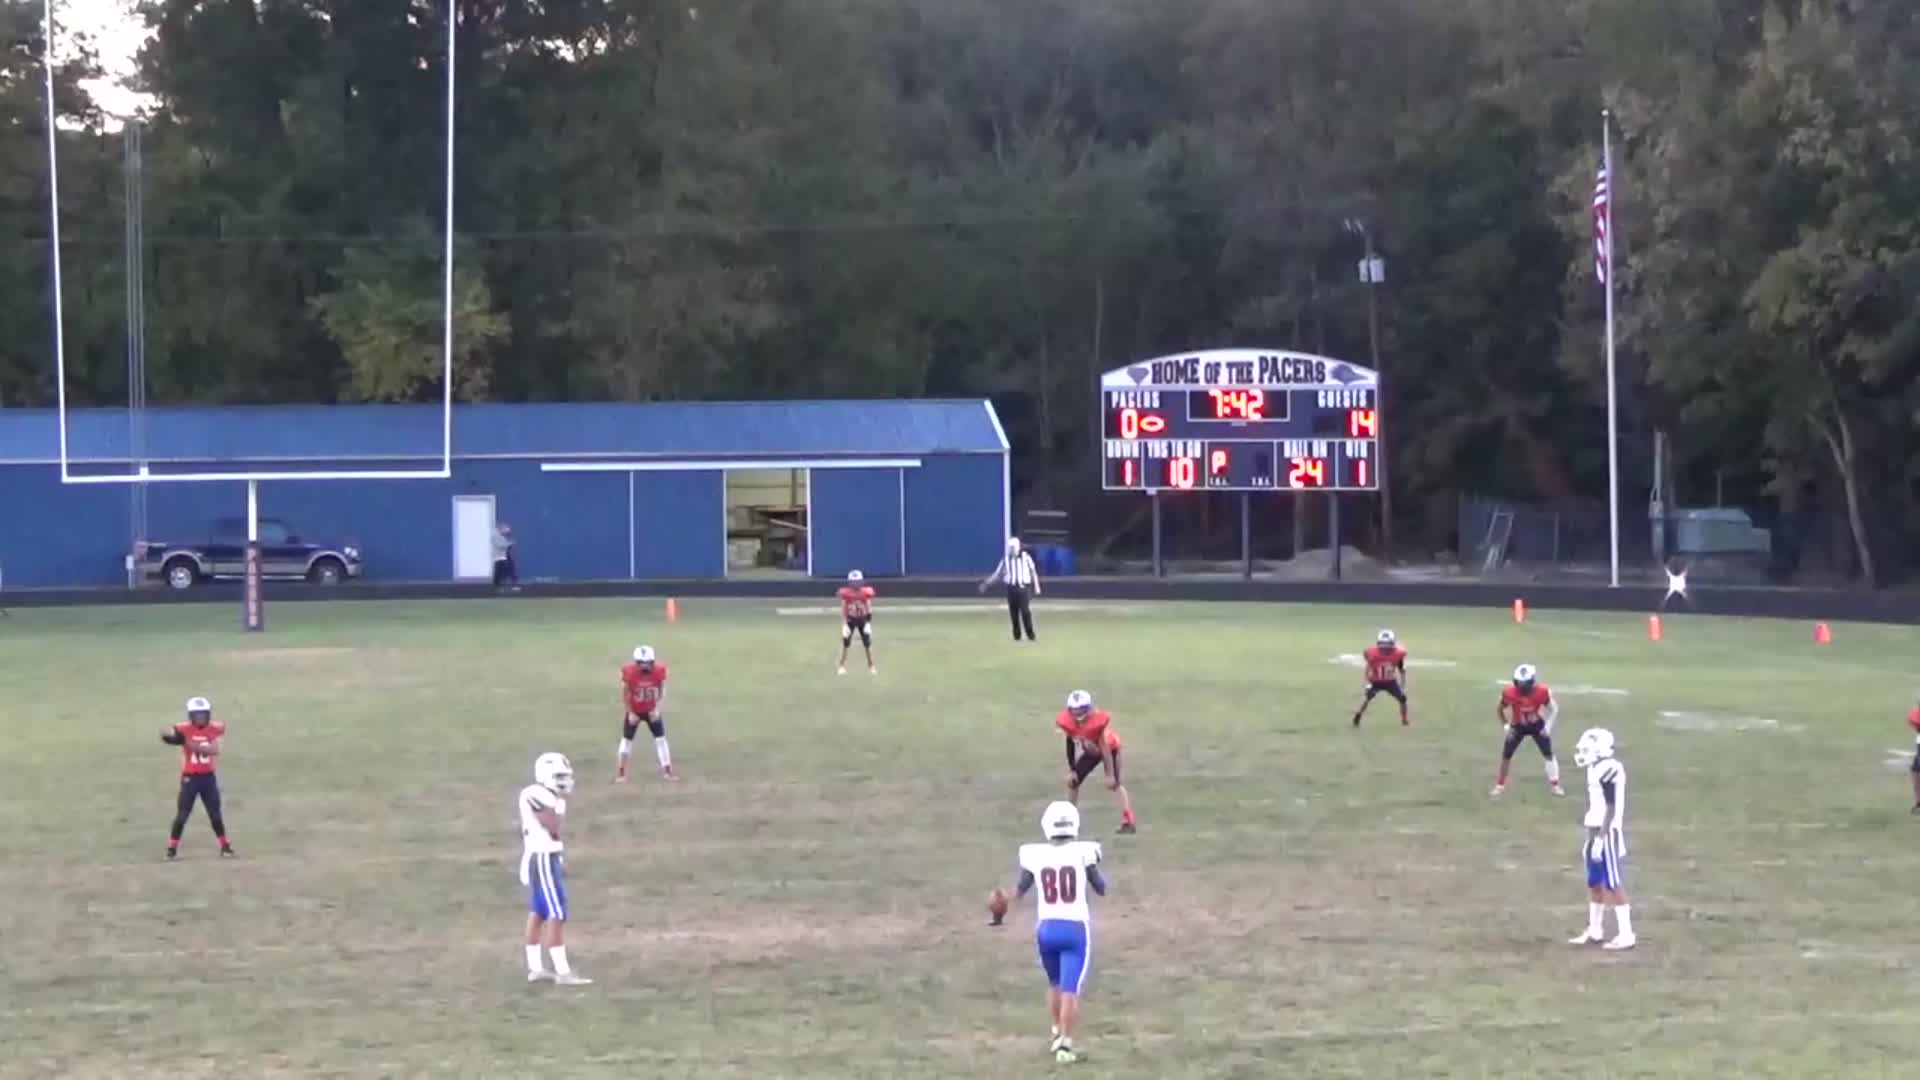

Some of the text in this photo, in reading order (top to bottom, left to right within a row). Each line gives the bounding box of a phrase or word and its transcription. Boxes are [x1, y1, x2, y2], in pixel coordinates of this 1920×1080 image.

[1151, 356, 1326, 385] HOME OF THE PACERS
[1207, 388, 1265, 421] 7:42
[1350, 410, 1376, 437] 14
[1124, 459, 1133, 486] 1
[1169, 458, 1194, 489] 10
[1289, 457, 1323, 489] 24
[1358, 459, 1367, 486] 1
[1041, 866, 1077, 904] 80
